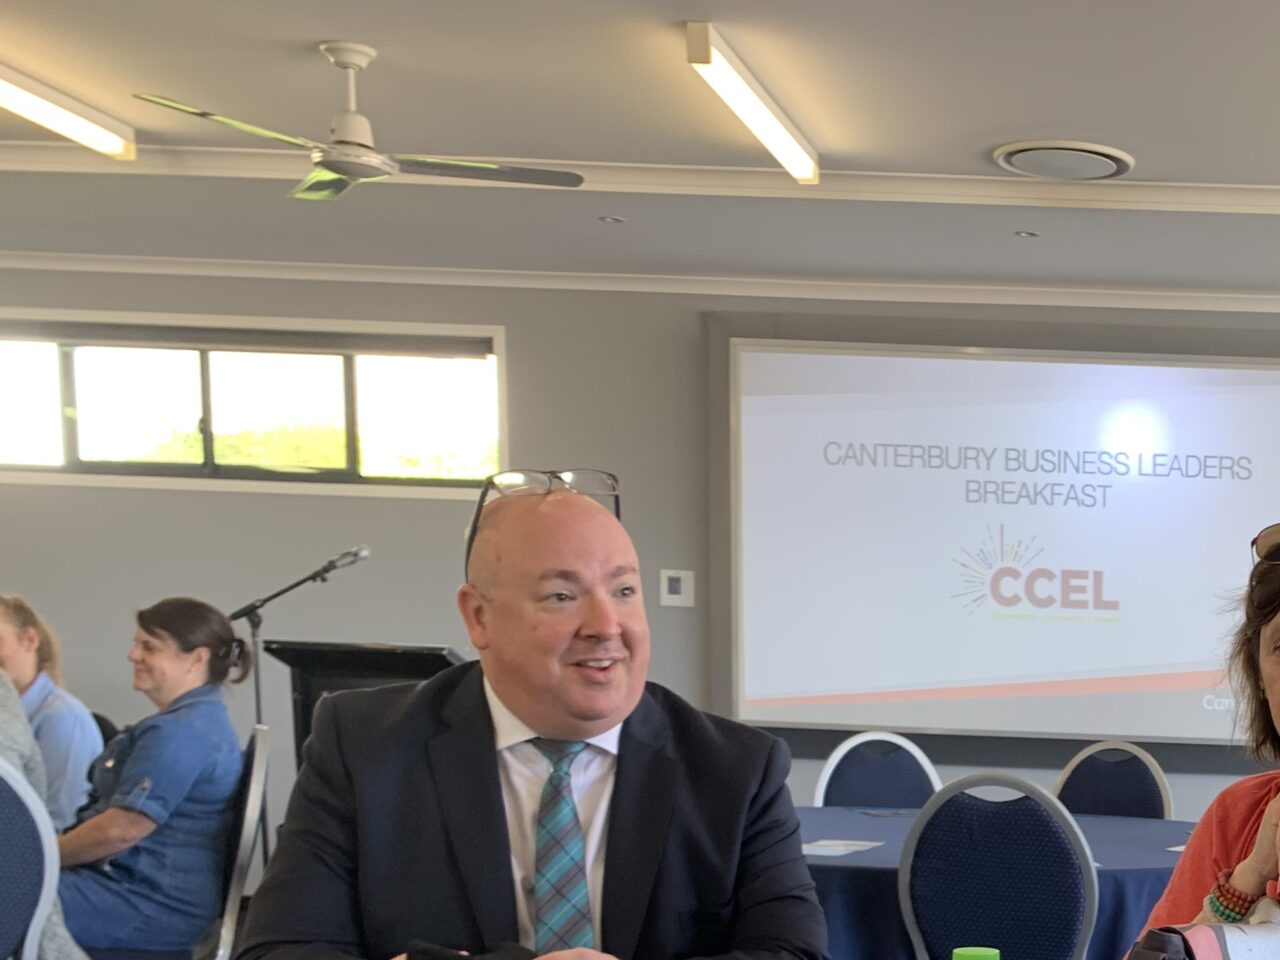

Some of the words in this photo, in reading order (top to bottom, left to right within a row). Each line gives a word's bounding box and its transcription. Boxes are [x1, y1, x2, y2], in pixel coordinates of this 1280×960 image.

[823, 441, 998, 471] CANTERBURY
[1004, 448, 1130, 476] BUSINESS
[1138, 453, 1253, 481] LEADERS
[965, 480, 1112, 508] BREAKFAST
[989, 566, 1120, 611] CCEL
